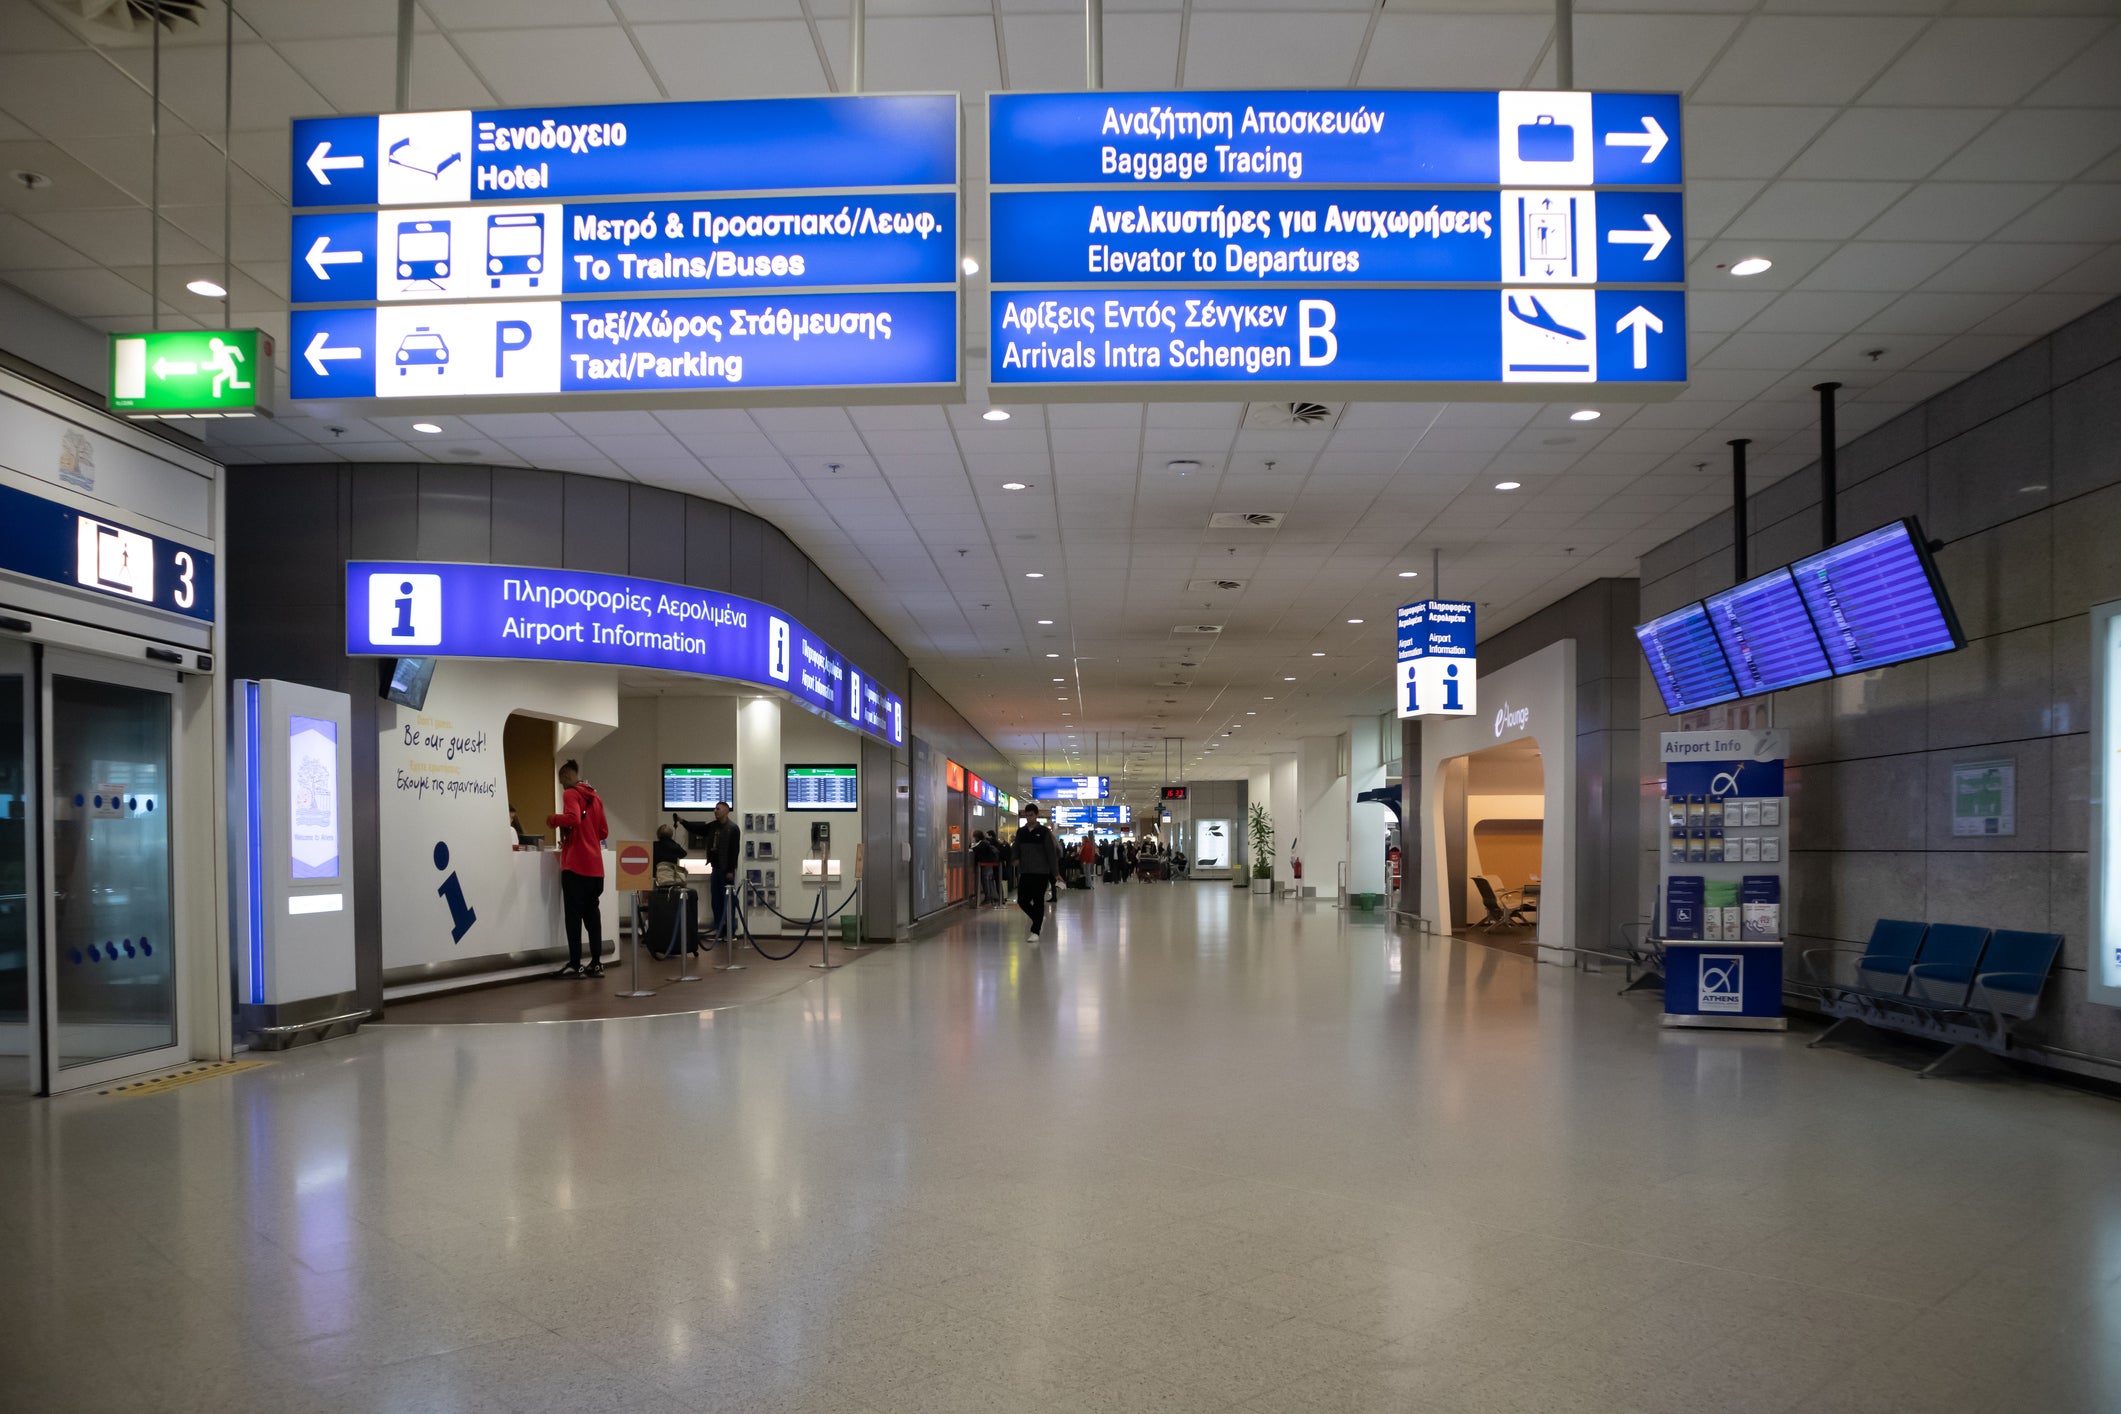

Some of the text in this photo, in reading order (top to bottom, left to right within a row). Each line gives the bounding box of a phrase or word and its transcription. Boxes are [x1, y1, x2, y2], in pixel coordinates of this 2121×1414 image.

[1102, 106, 1384, 139] Αναζήτηση Αποσκευών
[478, 163, 548, 190] Hotel
[1102, 145, 1302, 179] Baggage Tracing
[574, 207, 942, 245] Μετρό & Προαστιακό/Λεωφ.
[1089, 205, 1492, 238] Ανελκυστήρες για Αναχωρήσεις
[574, 251, 805, 280] To Trains/Buses
[1089, 244, 1359, 277] Elevator to Departures
[571, 307, 892, 344] Ταξί/Χώρος Στάθμευσης
[1002, 300, 1287, 333] Αφίξεις Εντός Σένγκεν
[1299, 300, 1337, 366] B
[570, 349, 745, 382] Taxi/Parking
[1003, 340, 1290, 373] Arrivals Intra Schengen
[174, 551, 194, 609] 3
[504, 580, 747, 629] Πληροφορίες Αερολιμένα
[503, 617, 706, 655] Airport Information
[1429, 632, 1451, 644] Airport
[1429, 644, 1466, 655] Information
[404, 724, 487, 760] Be our guest!
[1665, 739, 1742, 755] Airport Info
[432, 778, 445, 795] τις
[1702, 995, 1740, 1003] ATHENS
